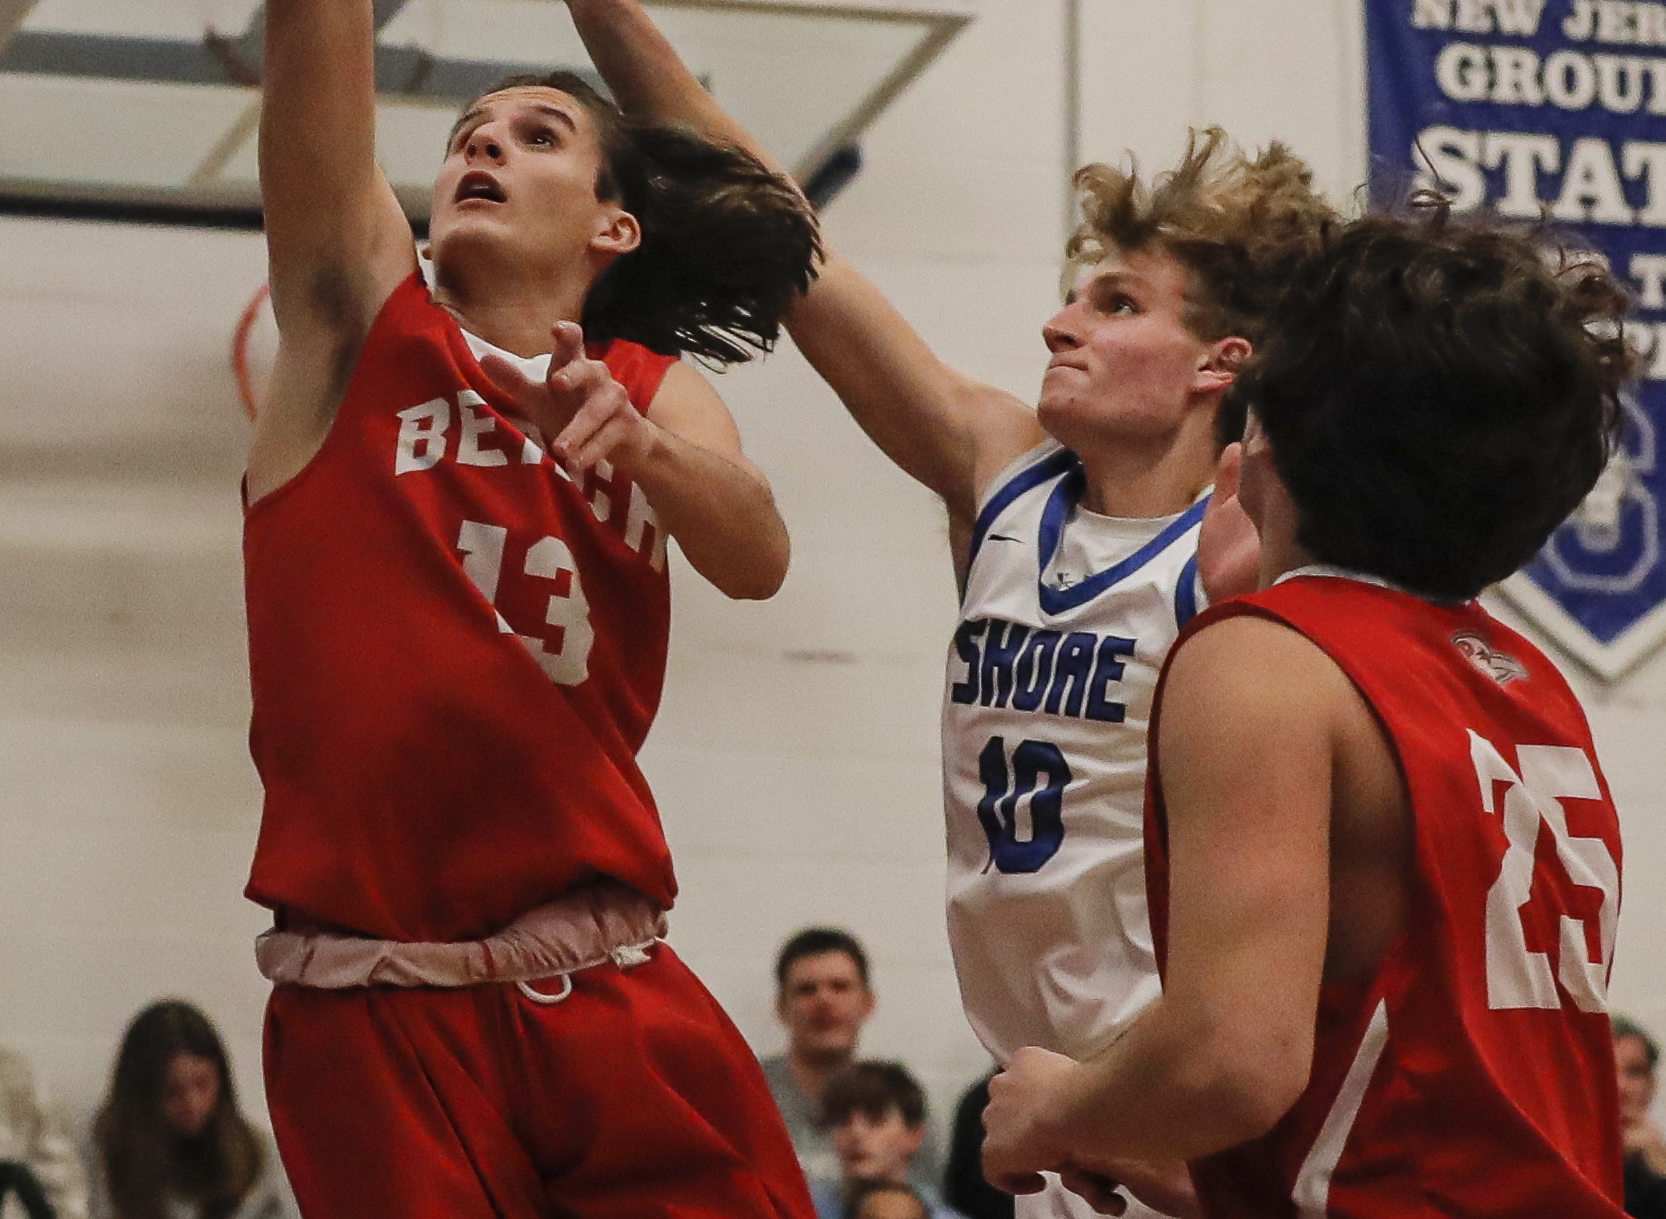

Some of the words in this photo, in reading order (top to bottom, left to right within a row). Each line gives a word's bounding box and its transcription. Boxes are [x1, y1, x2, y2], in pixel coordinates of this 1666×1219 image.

[456, 519, 595, 687] 13
[952, 618, 1137, 724] SHORE
[976, 735, 1073, 875] 10
[1465, 728, 1620, 1014] 25
